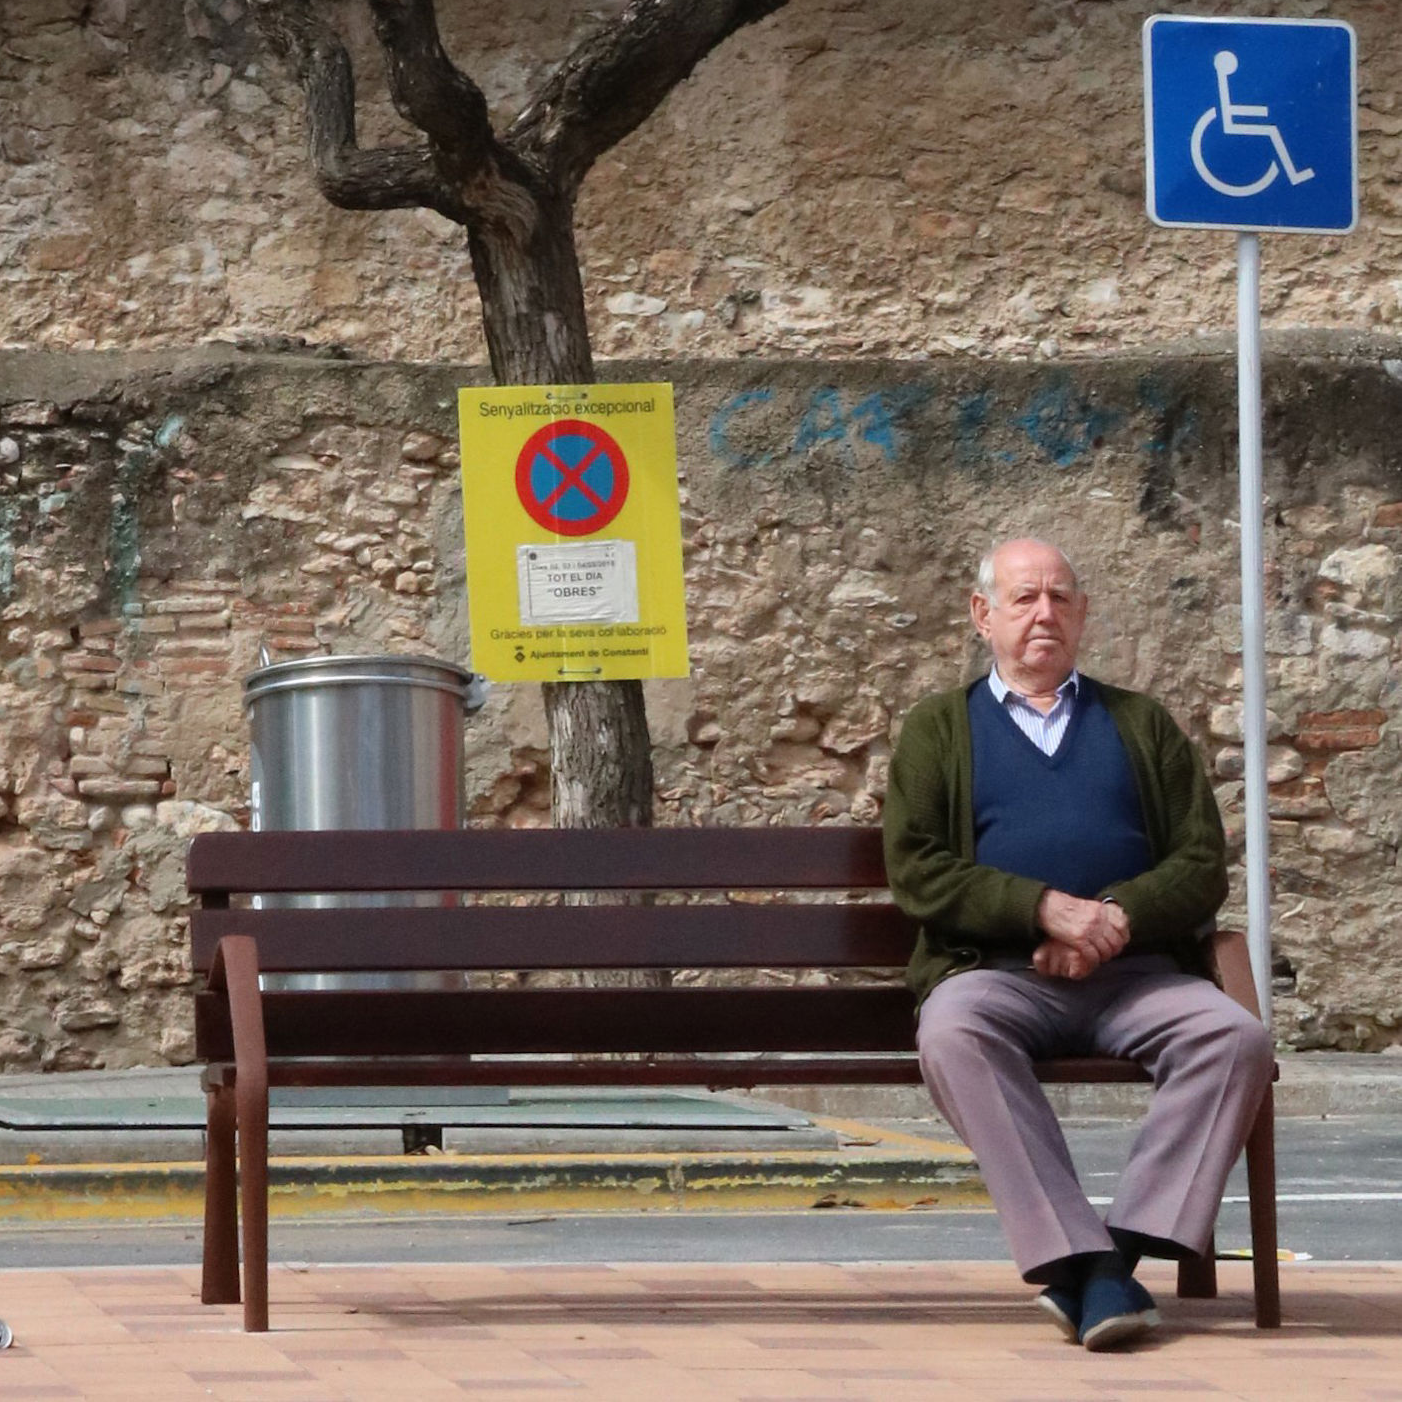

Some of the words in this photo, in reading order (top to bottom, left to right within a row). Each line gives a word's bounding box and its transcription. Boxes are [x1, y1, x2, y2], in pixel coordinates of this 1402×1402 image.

[574, 398, 655, 416] excepcional
[547, 574, 567, 583] TOT
[570, 573, 583, 582] EL
[585, 572, 603, 581] DIA
[536, 629, 554, 640] per
[569, 629, 596, 638] seva
[530, 650, 585, 659] Ajuntament
